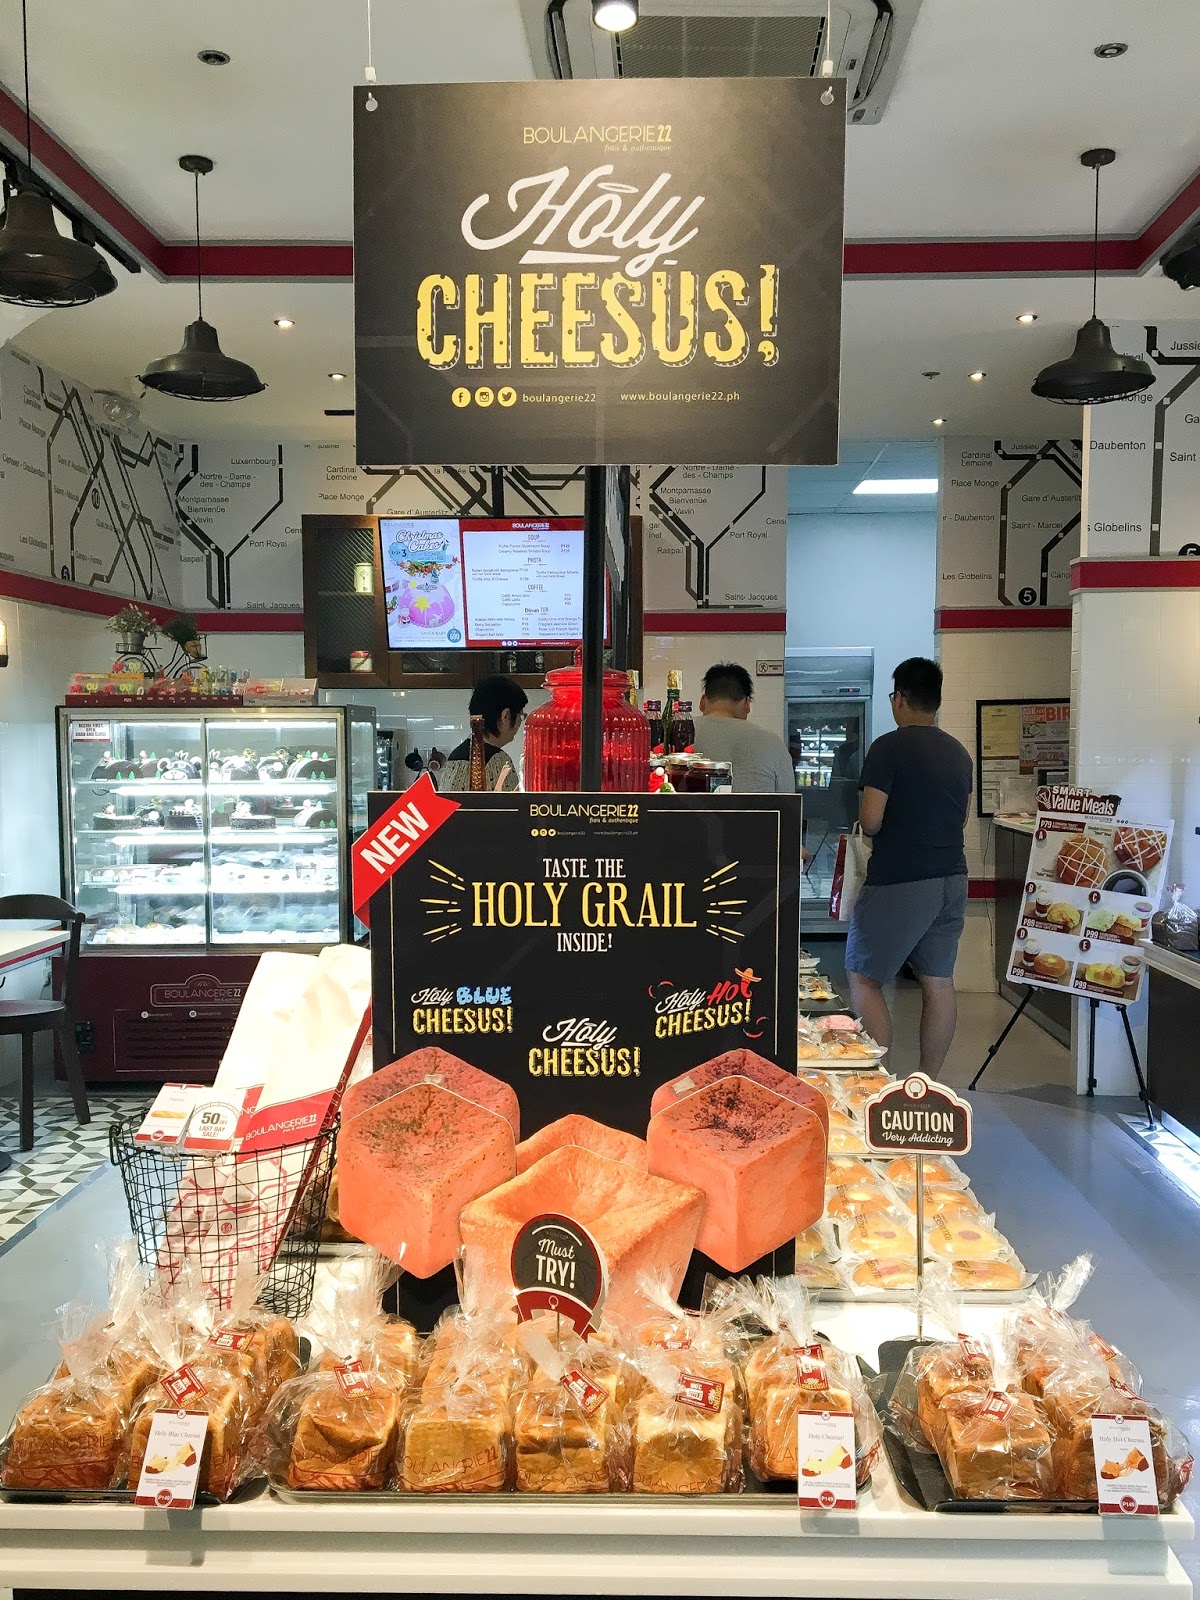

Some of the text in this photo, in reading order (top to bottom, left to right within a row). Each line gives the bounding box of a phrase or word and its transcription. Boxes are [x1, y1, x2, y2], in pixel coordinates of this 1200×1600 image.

[523, 124, 672, 144] BOULANGERIE22
[461, 164, 705, 277] Holy
[416, 264, 780, 370] CHEESUS!
[521, 391, 741, 404] boulangerie22 www.boulangerie22.ph
[1090, 440, 1146, 450] Daubenton
[961, 451, 993, 459] Cardinal
[1170, 452, 1196, 462] Saint
[231, 458, 277, 467] Luxembourg
[326, 473, 358, 481] Lemoine
[951, 479, 1000, 488] Place Monge
[220, 481, 251, 489] Champs
[660, 487, 712, 495] Montparnasse
[340, 493, 365, 502] Monge
[1094, 523, 1142, 532] Globelins
[396, 530, 445, 542] Christmas
[250, 540, 287, 549] Port Royal
[408, 539, 442, 552] Cakes
[958, 572, 993, 580] Globelins
[748, 593, 778, 602] Jacques
[1023, 590, 1033, 603] 5
[1052, 786, 1092, 797] SMART
[530, 804, 639, 817] BOULANGERIE22
[1051, 794, 1115, 816] Value Meals
[1041, 820, 1053, 829] P79
[359, 800, 431, 875] NEW
[543, 858, 626, 878] TASTE THE
[472, 882, 698, 928] HOLY GRAIL
[557, 933, 613, 952] INSIDE!
[411, 986, 513, 1006] Holy BLUE
[655, 988, 707, 1014] Holy
[412, 1006, 513, 1034] CHEESUS!
[655, 998, 753, 1039] CHEESUS!
[542, 1017, 618, 1050] Holy
[528, 1047, 641, 1077] CHEESUS!
[245, 1114, 317, 1141] BOULANGERIE22
[881, 1110, 954, 1133] CAUTION
[882, 1131, 954, 1147] Very Addicting
[538, 1239, 575, 1259] Must
[535, 1254, 576, 1289] TRY!
